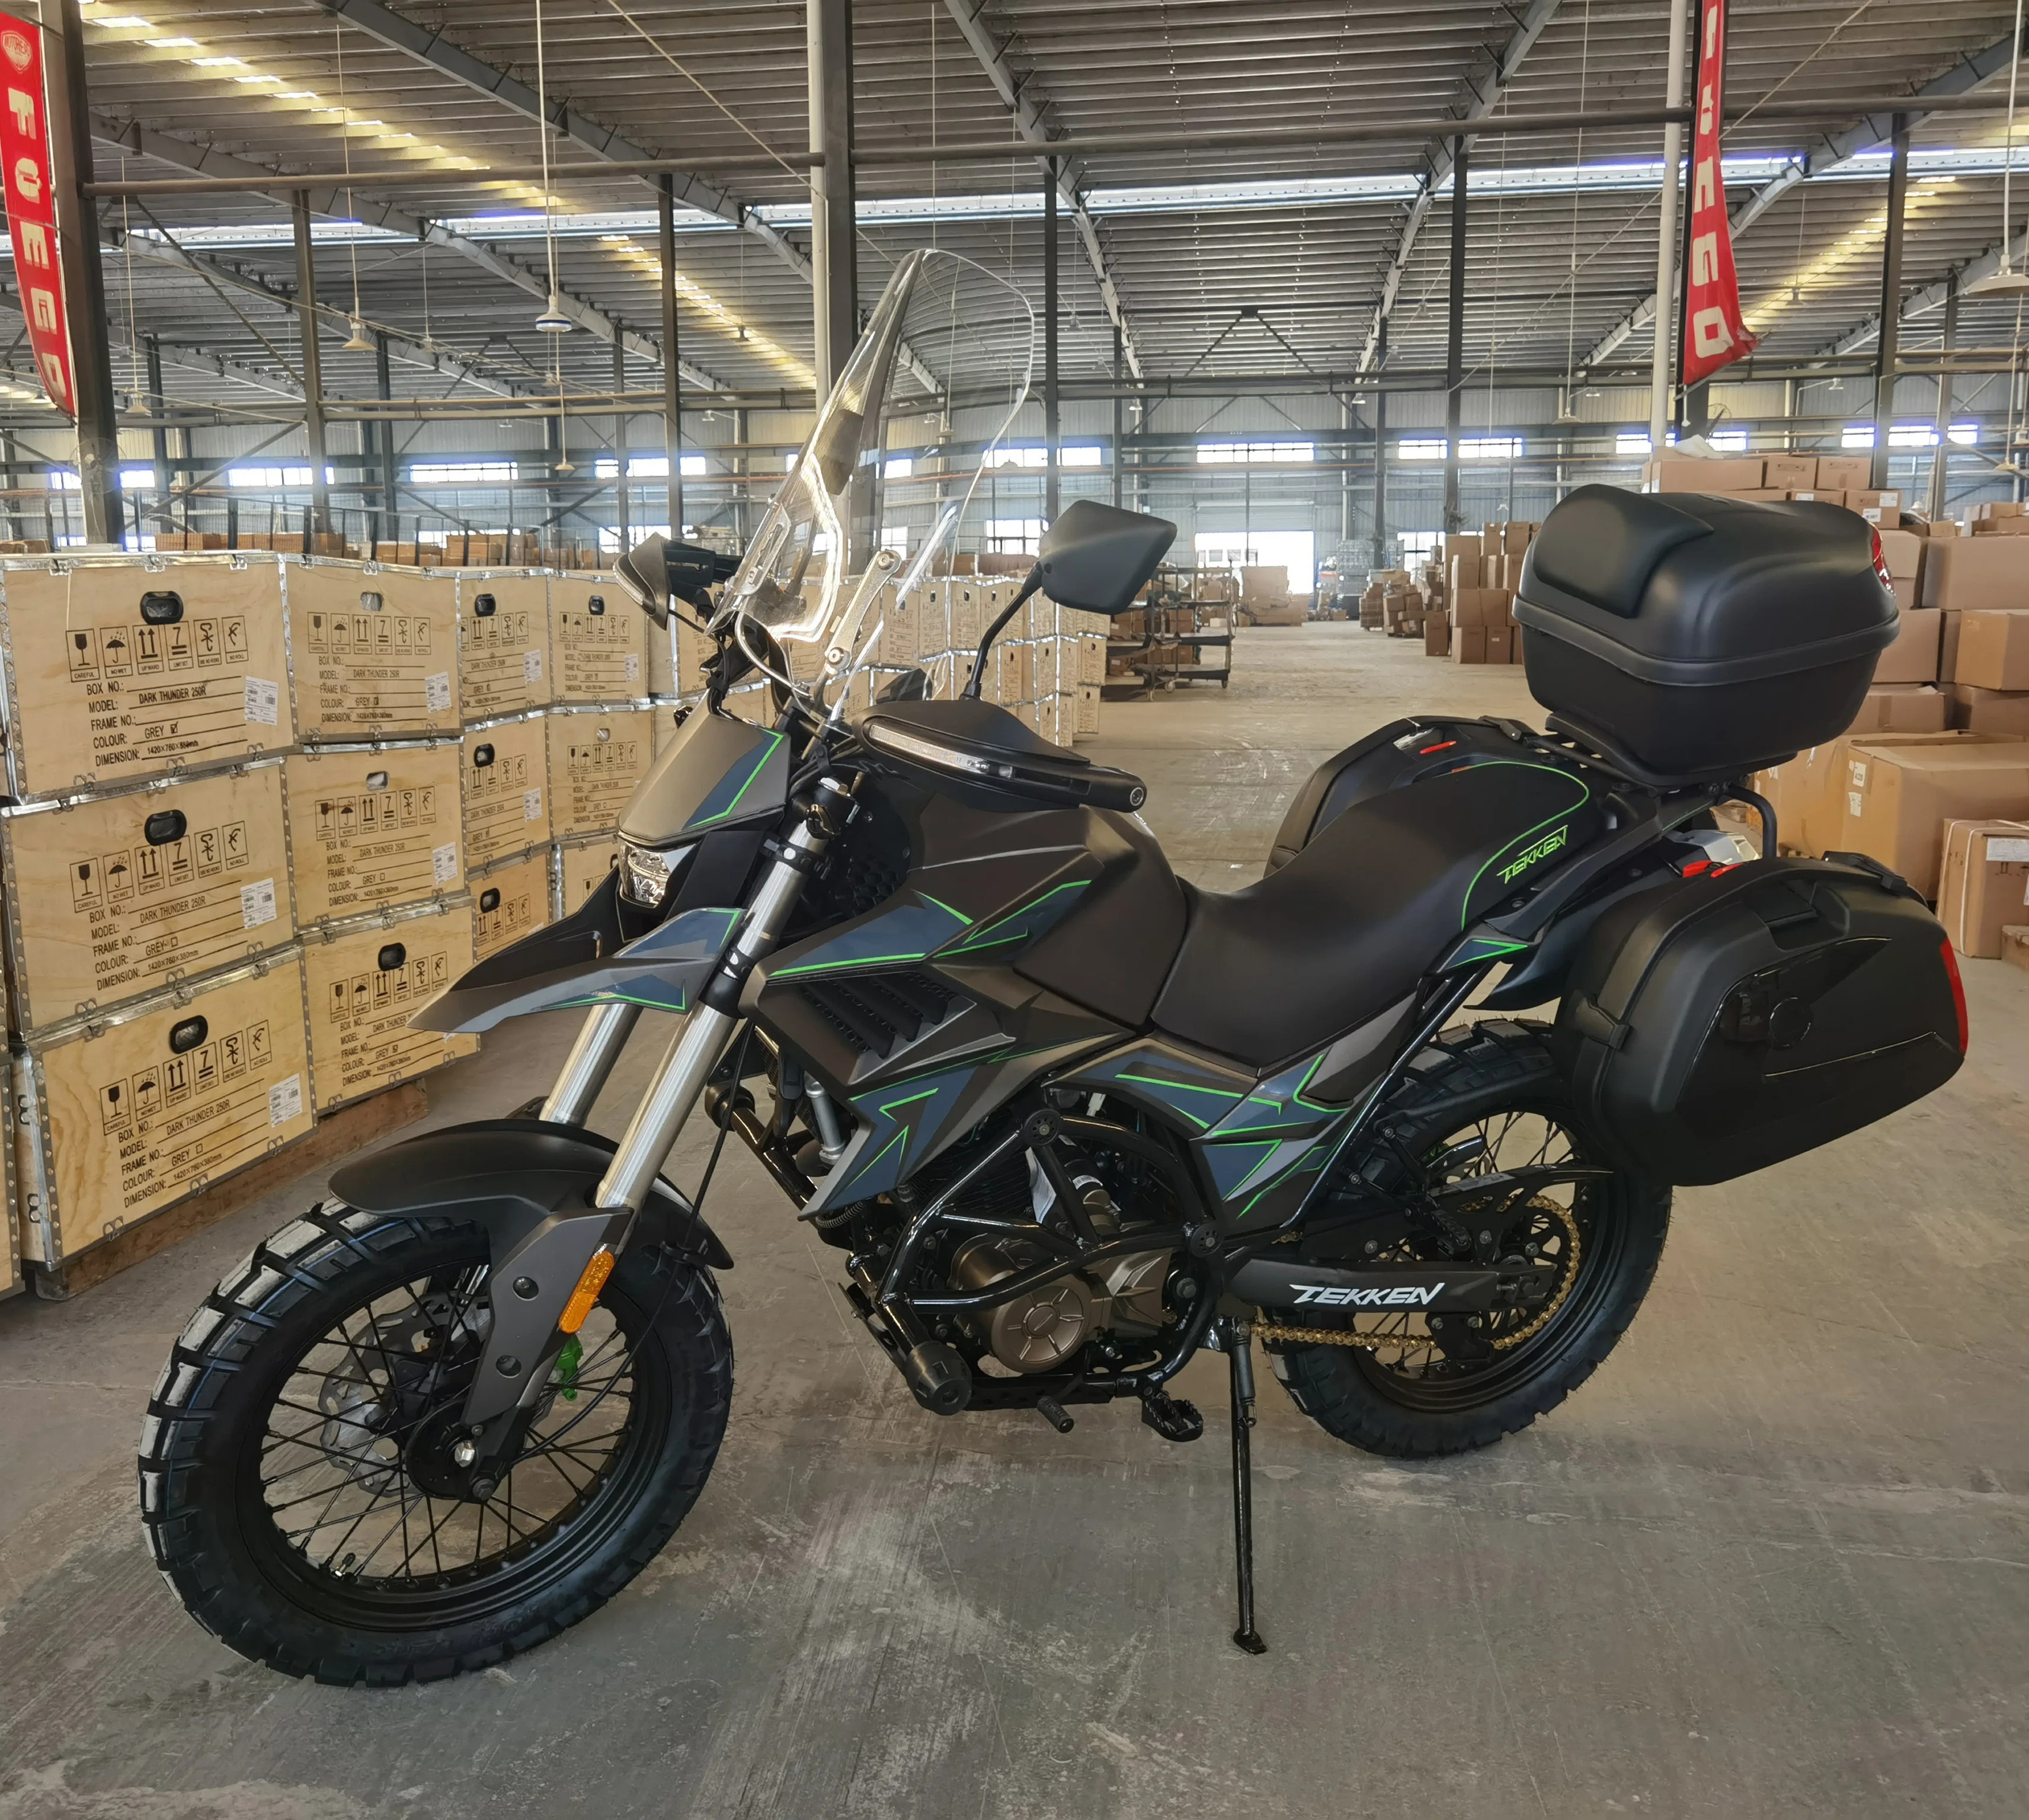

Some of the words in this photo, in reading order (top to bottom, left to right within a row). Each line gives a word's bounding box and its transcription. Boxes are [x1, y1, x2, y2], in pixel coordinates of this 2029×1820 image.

[318, 656, 330, 665] BOX
[319, 670, 340, 680] MODEL:
[353, 669, 366, 678] DARK
[367, 669, 389, 678] THUNDER
[87, 683, 104, 696] BOX
[320, 684, 338, 694] FRAME
[88, 699, 119, 713] MODEL:
[139, 693, 158, 704] DARK
[159, 688, 190, 701] THUNDER
[191, 685, 207, 697] 250R
[321, 699, 344, 709] COLOUR:
[356, 697, 370, 706] GREY
[91, 716, 118, 732] FRAME
[321, 713, 352, 723] DIMENSION:
[93, 733, 127, 749] COLOUR:
[145, 725, 164, 739] GREY
[95, 749, 140, 767] DIMENSION:
[326, 841, 337, 851] BOX
[327, 854, 346, 864] MODEL:
[360, 848, 373, 857] DARK
[373, 844, 394, 854] THUNDER
[1496, 824, 1569, 884] TEKKEN
[327, 867, 345, 879] FRAME
[328, 880, 351, 893] COLOUR:
[363, 874, 376, 885] GREY
[78, 899, 98, 909] CAREFUL
[329, 892, 359, 906] DIMENSION:
[89, 909, 106, 923] BOX
[91, 924, 120, 940] MODEL:
[140, 910, 158, 924] DARK
[159, 900, 190, 917] THUNDER
[191, 896, 206, 908] 250R
[93, 939, 119, 957] FRAME
[95, 954, 129, 974] COLOUR:
[146, 940, 164, 956] GREY
[97, 967, 141, 991] DIMENSION:
[107, 1120, 126, 1131] CAREFUL
[120, 1140, 148, 1159] MODEL:
[167, 1120, 184, 1135] DARK
[185, 1107, 215, 1124] THUNDER
[216, 1099, 231, 1113] 250R
[119, 1127, 135, 1143] BOX
[121, 1155, 147, 1175] FRAME
[123, 1168, 155, 1191] COLOUR:
[171, 1149, 190, 1167] GREY
[124, 1179, 167, 1208] DIMENSION:
[1289, 1282, 1445, 1305] TEKKEN
